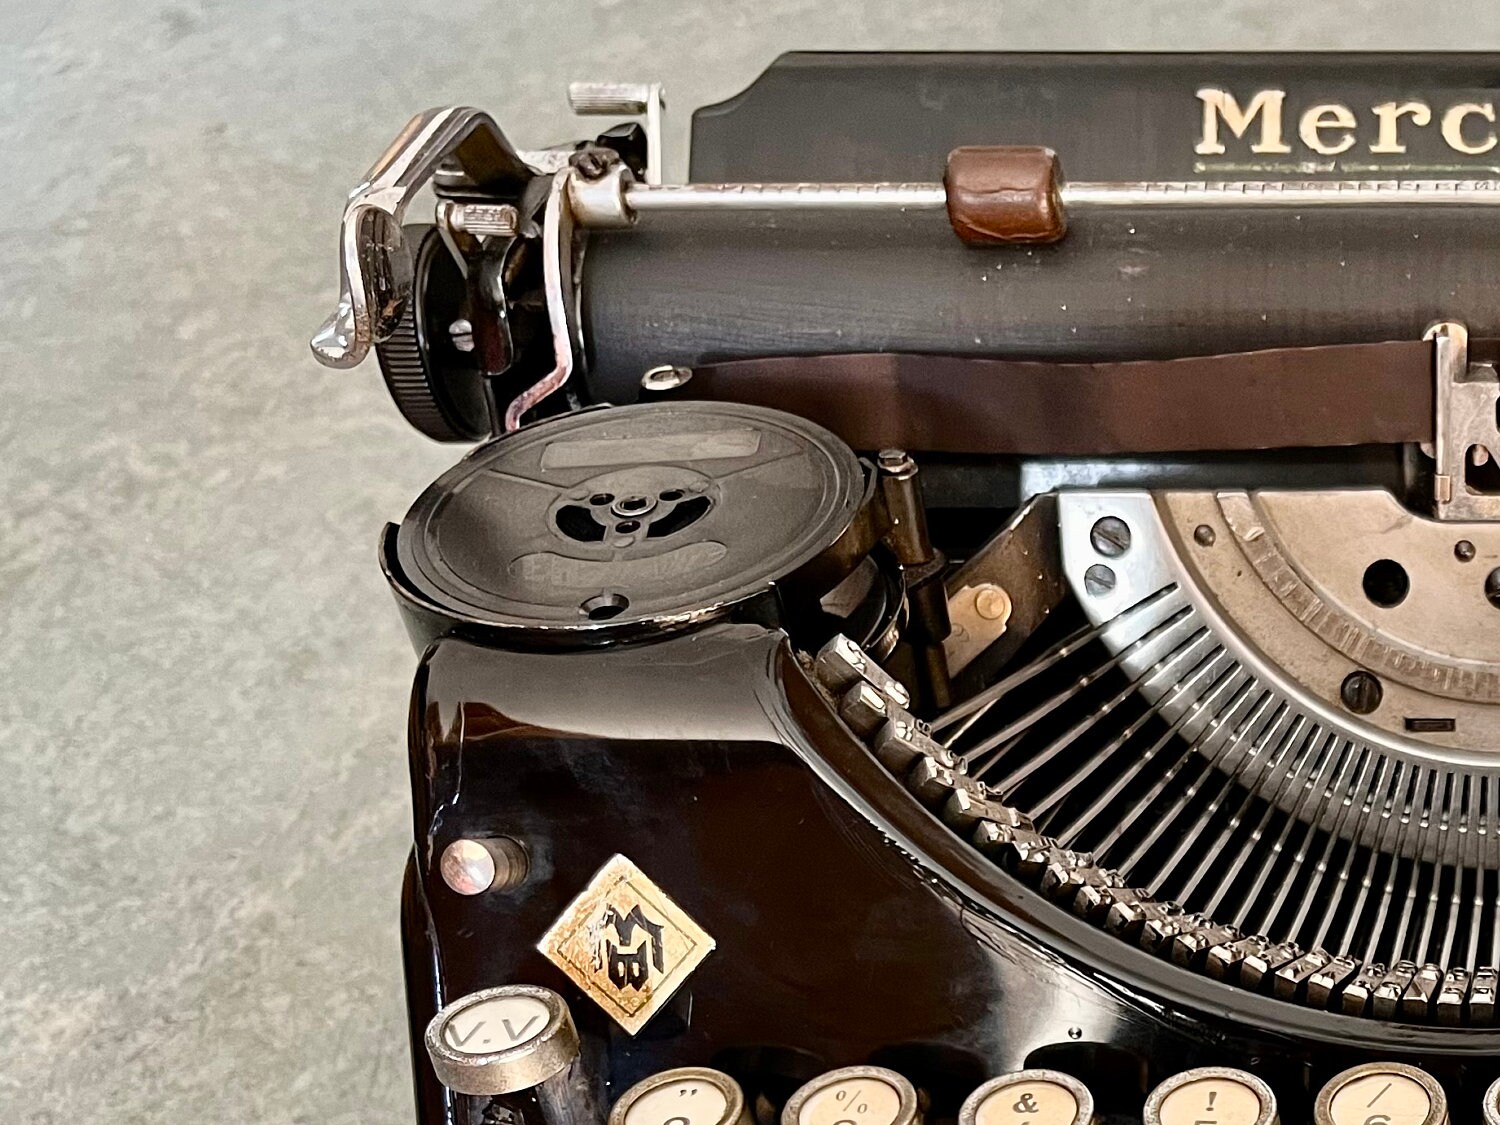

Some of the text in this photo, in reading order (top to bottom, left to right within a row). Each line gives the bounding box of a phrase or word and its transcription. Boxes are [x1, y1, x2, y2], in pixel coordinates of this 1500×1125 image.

[835, 1090, 868, 1113] %
[1012, 1092, 1039, 1114] &
[1205, 1091, 1217, 1112] !
